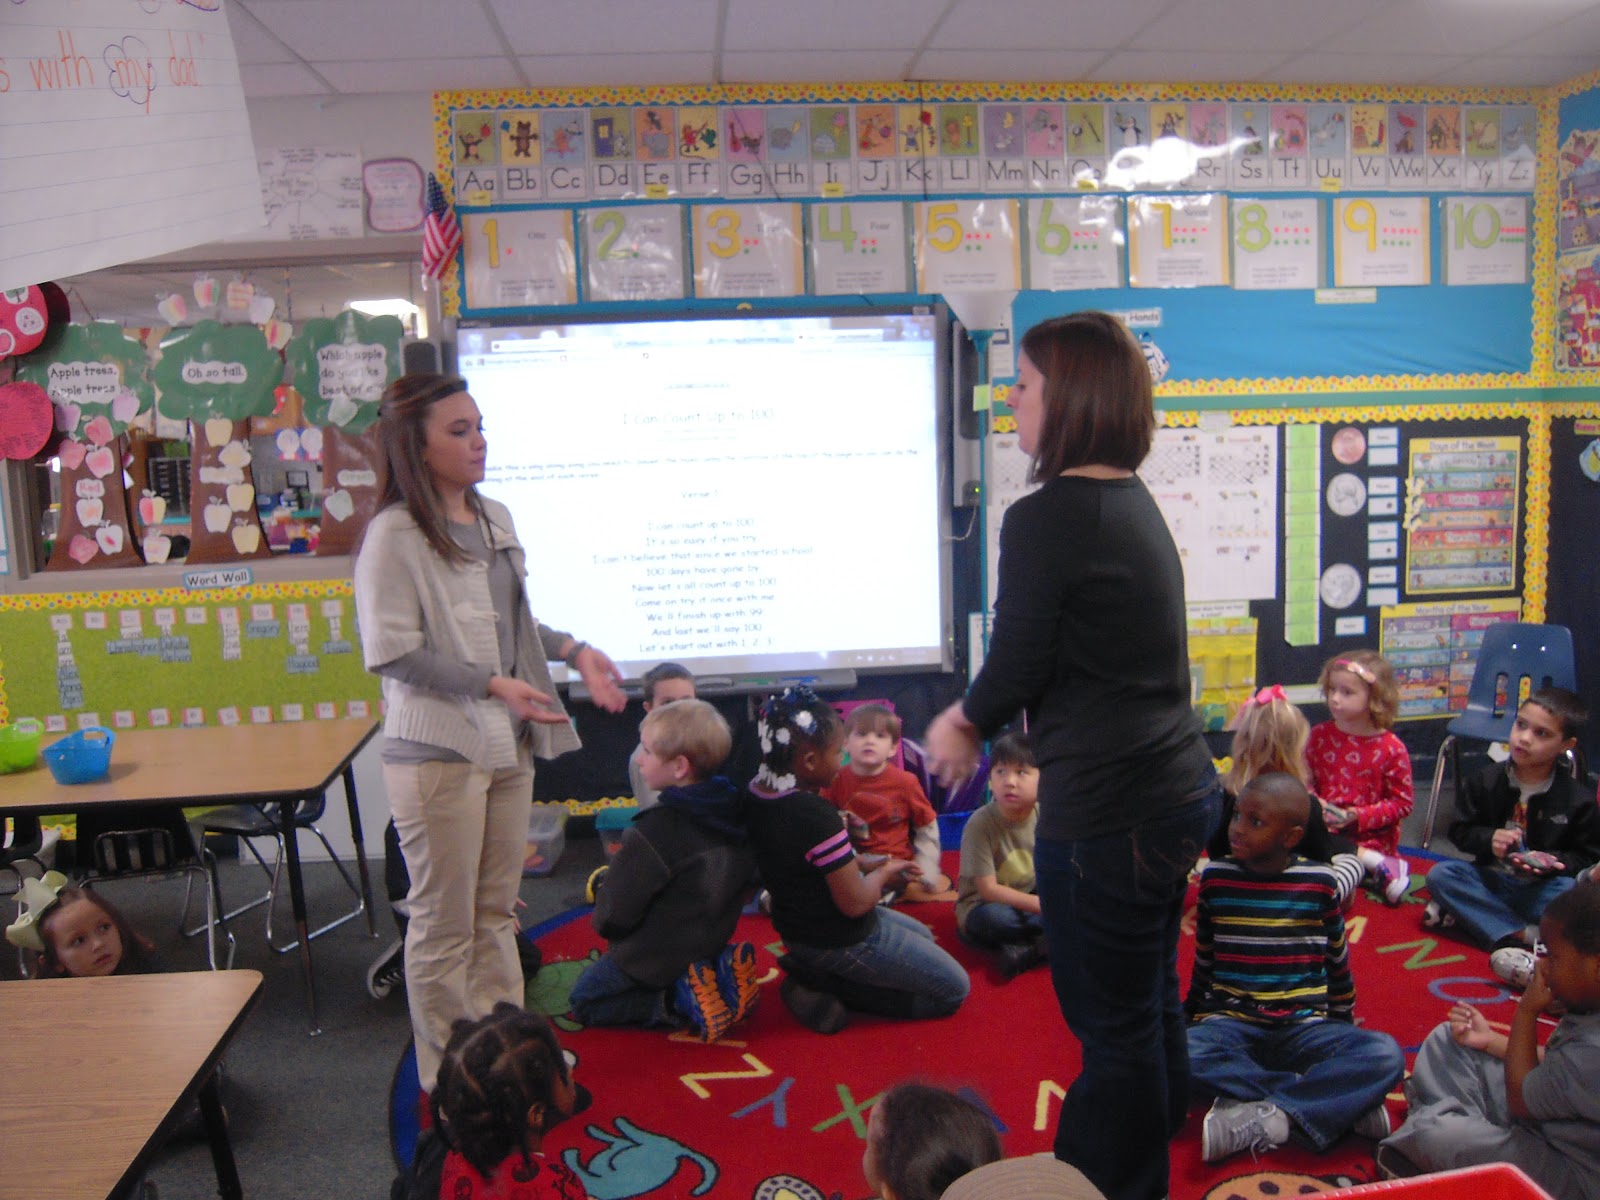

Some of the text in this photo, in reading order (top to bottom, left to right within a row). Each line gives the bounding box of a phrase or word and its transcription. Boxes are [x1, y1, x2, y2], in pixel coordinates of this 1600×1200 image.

[29, 30, 95, 91] with
[114, 57, 151, 115] my
[463, 170, 495, 191] Aa
[506, 167, 537, 190] Bb
[550, 166, 581, 189] Cc
[599, 164, 628, 186] Dd
[644, 163, 669, 185] Ee
[688, 163, 712, 184] Ff
[730, 164, 763, 194] Gg
[773, 163, 804, 184] Hh
[826, 161, 838, 184] Ii
[863, 160, 890, 191] Jj
[905, 159, 933, 181] Kk
[950, 159, 970, 180] Ll
[987, 159, 1024, 181] Mm
[1032, 159, 1060, 180] Nn
[1197, 157, 1221, 178] Rr
[1239, 158, 1263, 179] Ss
[1277, 157, 1299, 178] Tt
[1315, 158, 1341, 178] Uu
[1358, 157, 1381, 177] Vv
[1389, 157, 1425, 178] Ww
[1431, 157, 1457, 177] Xx
[1473, 160, 1494, 188] Yy
[1507, 159, 1530, 180] Zz
[706, 207, 742, 259] 3
[818, 205, 858, 253] 4
[870, 221, 890, 231] Four
[926, 203, 963, 253] 5
[1036, 201, 1071, 256] 6
[1150, 202, 1172, 249] 7
[1236, 204, 1271, 252] 8
[1343, 199, 1377, 253] 9
[1452, 203, 1500, 250] 10
[527, 231, 548, 240] One
[593, 210, 632, 262] 2
[482, 218, 499, 269] 1
[320, 349, 383, 363] Which apple
[50, 366, 81, 381] Apple
[187, 367, 203, 379] Oh
[206, 369, 220, 378] so
[321, 367, 335, 379] do
[634, 413, 658, 425] Can
[80, 481, 100, 493] Red
[683, 536, 706, 548] easy
[722, 535, 740, 547] you
[630, 551, 667, 563] believe
[694, 565, 718, 575] have
[187, 571, 247, 587] Word Wall
[631, 583, 656, 593] Now
[699, 579, 727, 590] count
[635, 598, 662, 608] Come
[736, 593, 759, 604] with
[677, 608, 707, 620] finish
[724, 607, 747, 618] with
[651, 627, 673, 637] And
[675, 625, 694, 636] last
[724, 625, 741, 637] say
[744, 621, 763, 633] 100
[669, 641, 694, 651] start
[697, 639, 714, 650] out
[716, 637, 739, 649] with
[730, 1077, 796, 1128] Y
